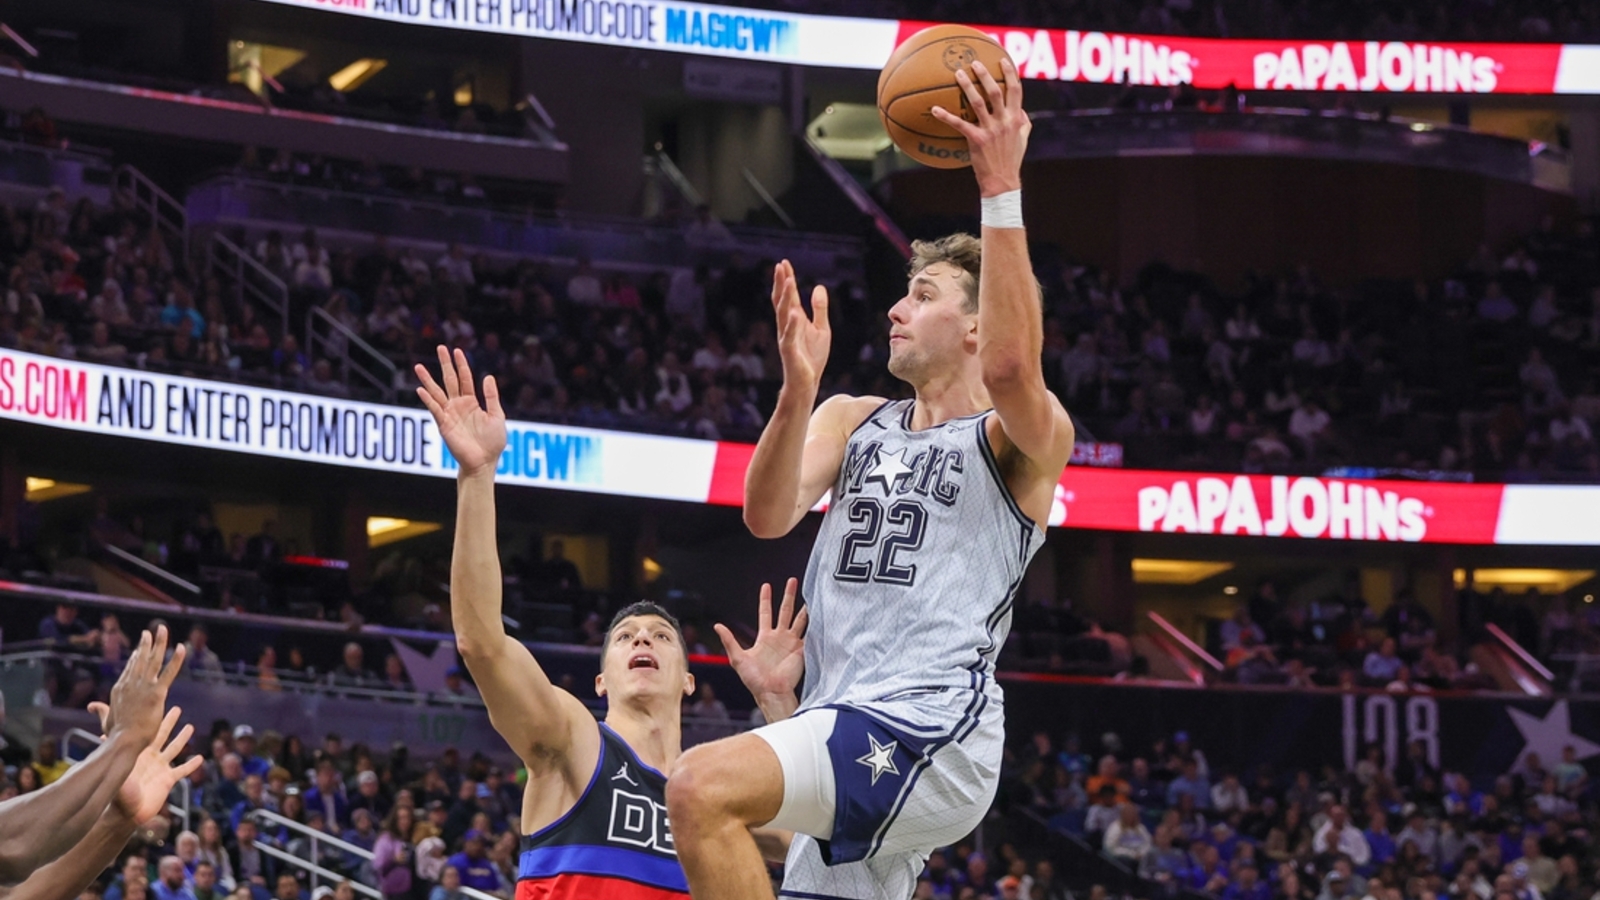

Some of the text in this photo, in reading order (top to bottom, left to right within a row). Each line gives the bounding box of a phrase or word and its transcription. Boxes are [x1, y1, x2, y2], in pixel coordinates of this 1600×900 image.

[511, 0, 656, 42] PROMOCODE
[97, 375, 155, 431] AND
[166, 384, 250, 445] ENTER
[261, 397, 431, 468] PROMOCODE
[833, 497, 928, 586] 22
